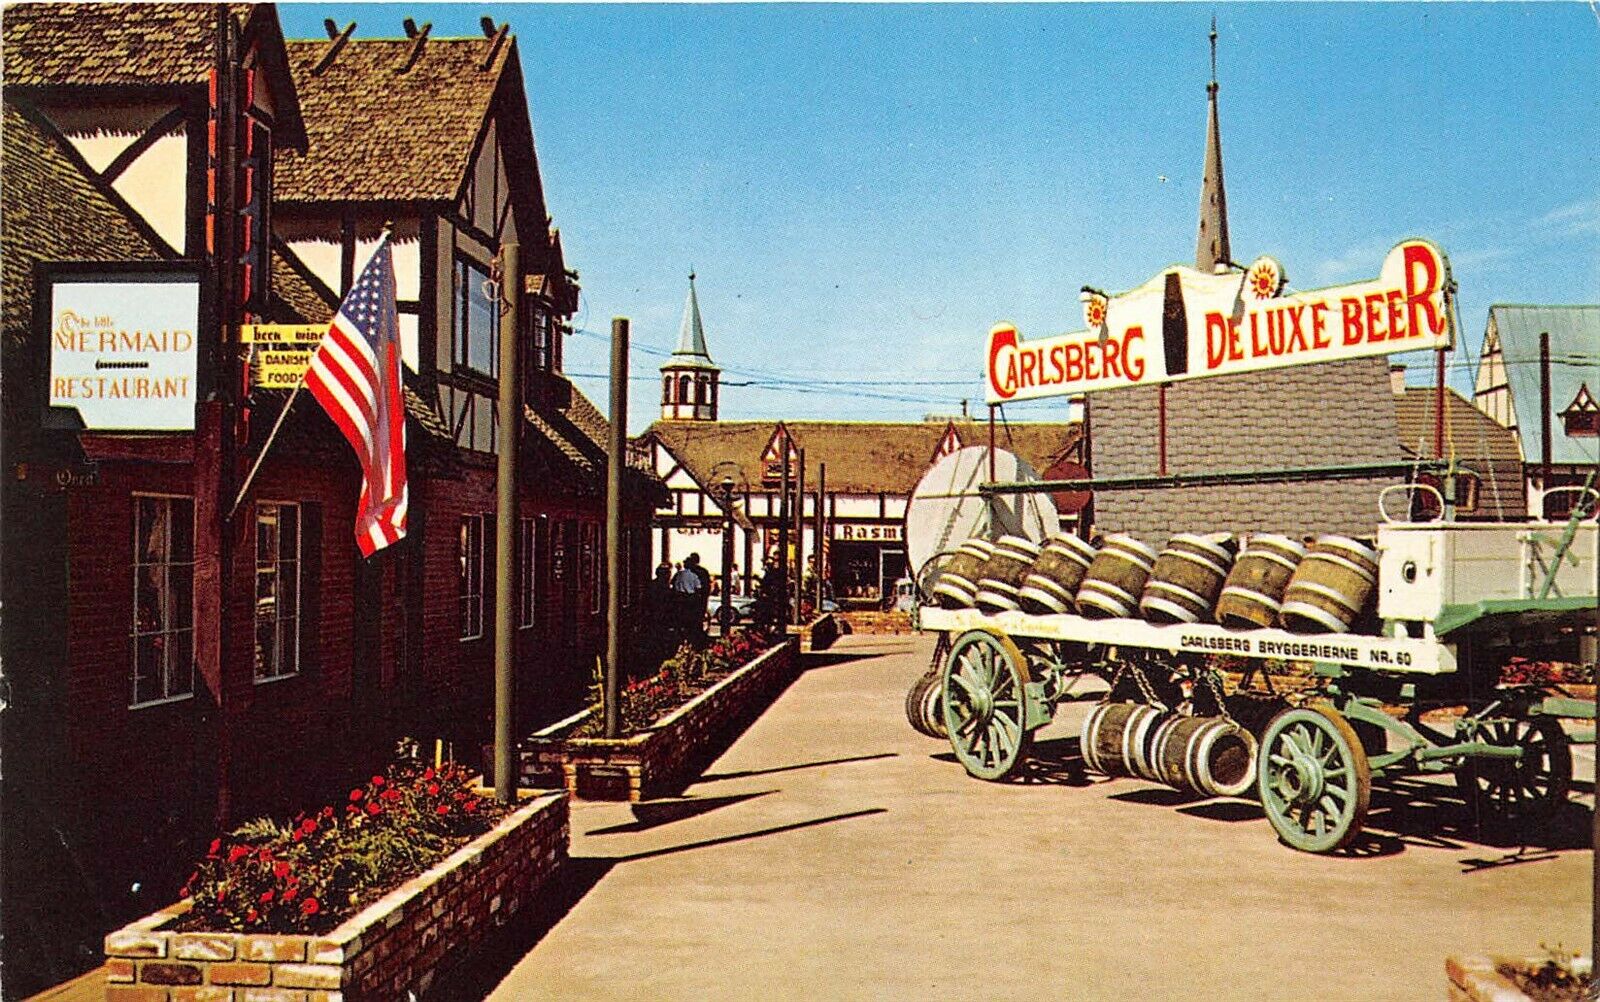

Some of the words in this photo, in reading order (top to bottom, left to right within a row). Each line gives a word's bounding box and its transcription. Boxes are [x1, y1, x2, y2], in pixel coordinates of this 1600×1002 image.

[1250, 301, 1331, 357] LUXE
[1341, 240, 1446, 346] BEER
[55, 330, 192, 352] MERMAID
[989, 327, 1146, 398] CARLSBERG
[53, 376, 189, 399] RESTAURANT
[268, 373, 304, 383] FOOD
[1180, 635, 1250, 652] CARLSBERG
[1259, 640, 1358, 660] BRYGGERIERNE
